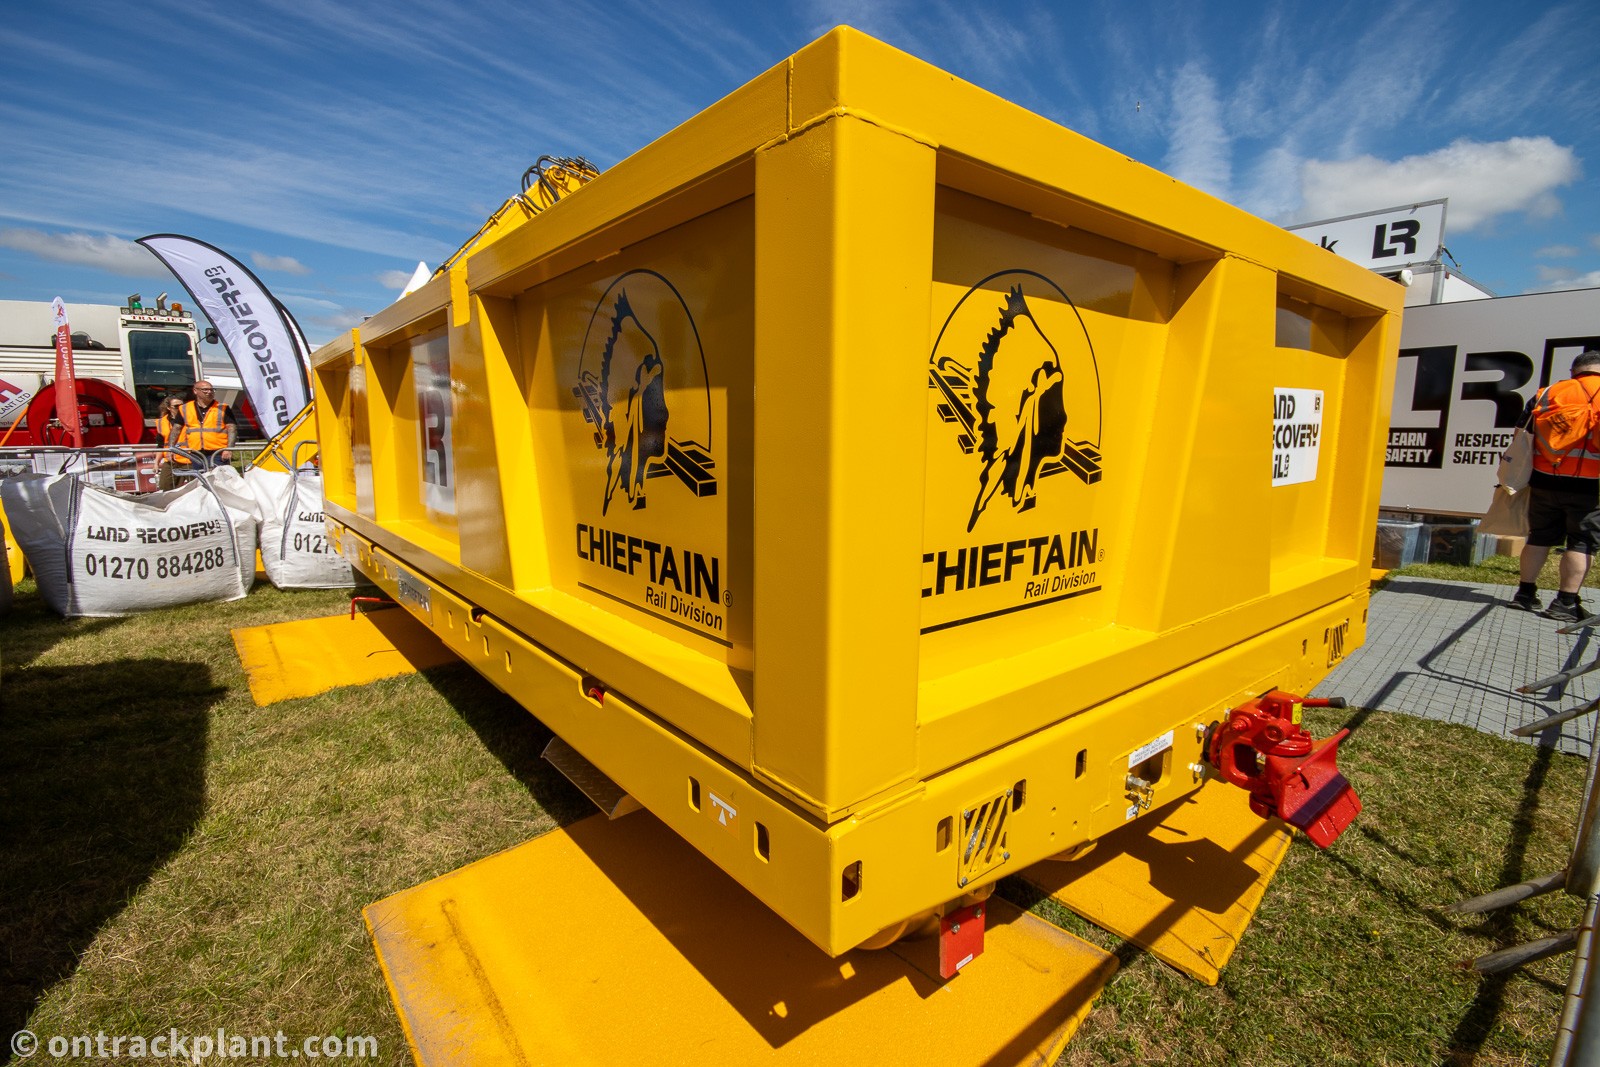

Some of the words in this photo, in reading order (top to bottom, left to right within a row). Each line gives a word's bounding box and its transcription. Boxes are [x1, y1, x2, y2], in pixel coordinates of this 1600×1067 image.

[1371, 219, 1420, 259] LR
[209, 277, 281, 391] RECOVERY
[1384, 448, 1433, 463] SAFETY
[86, 525, 130, 543] LAND
[136, 521, 216, 544] RECOVERY
[85, 553, 149, 580] 01270
[156, 546, 224, 579] 884288
[576, 522, 720, 605] CHIEFTAIN
[1023, 578, 1049, 600] Rail
[1051, 570, 1096, 593] Division
[645, 586, 667, 610] Rail
[670, 594, 723, 631] Division
